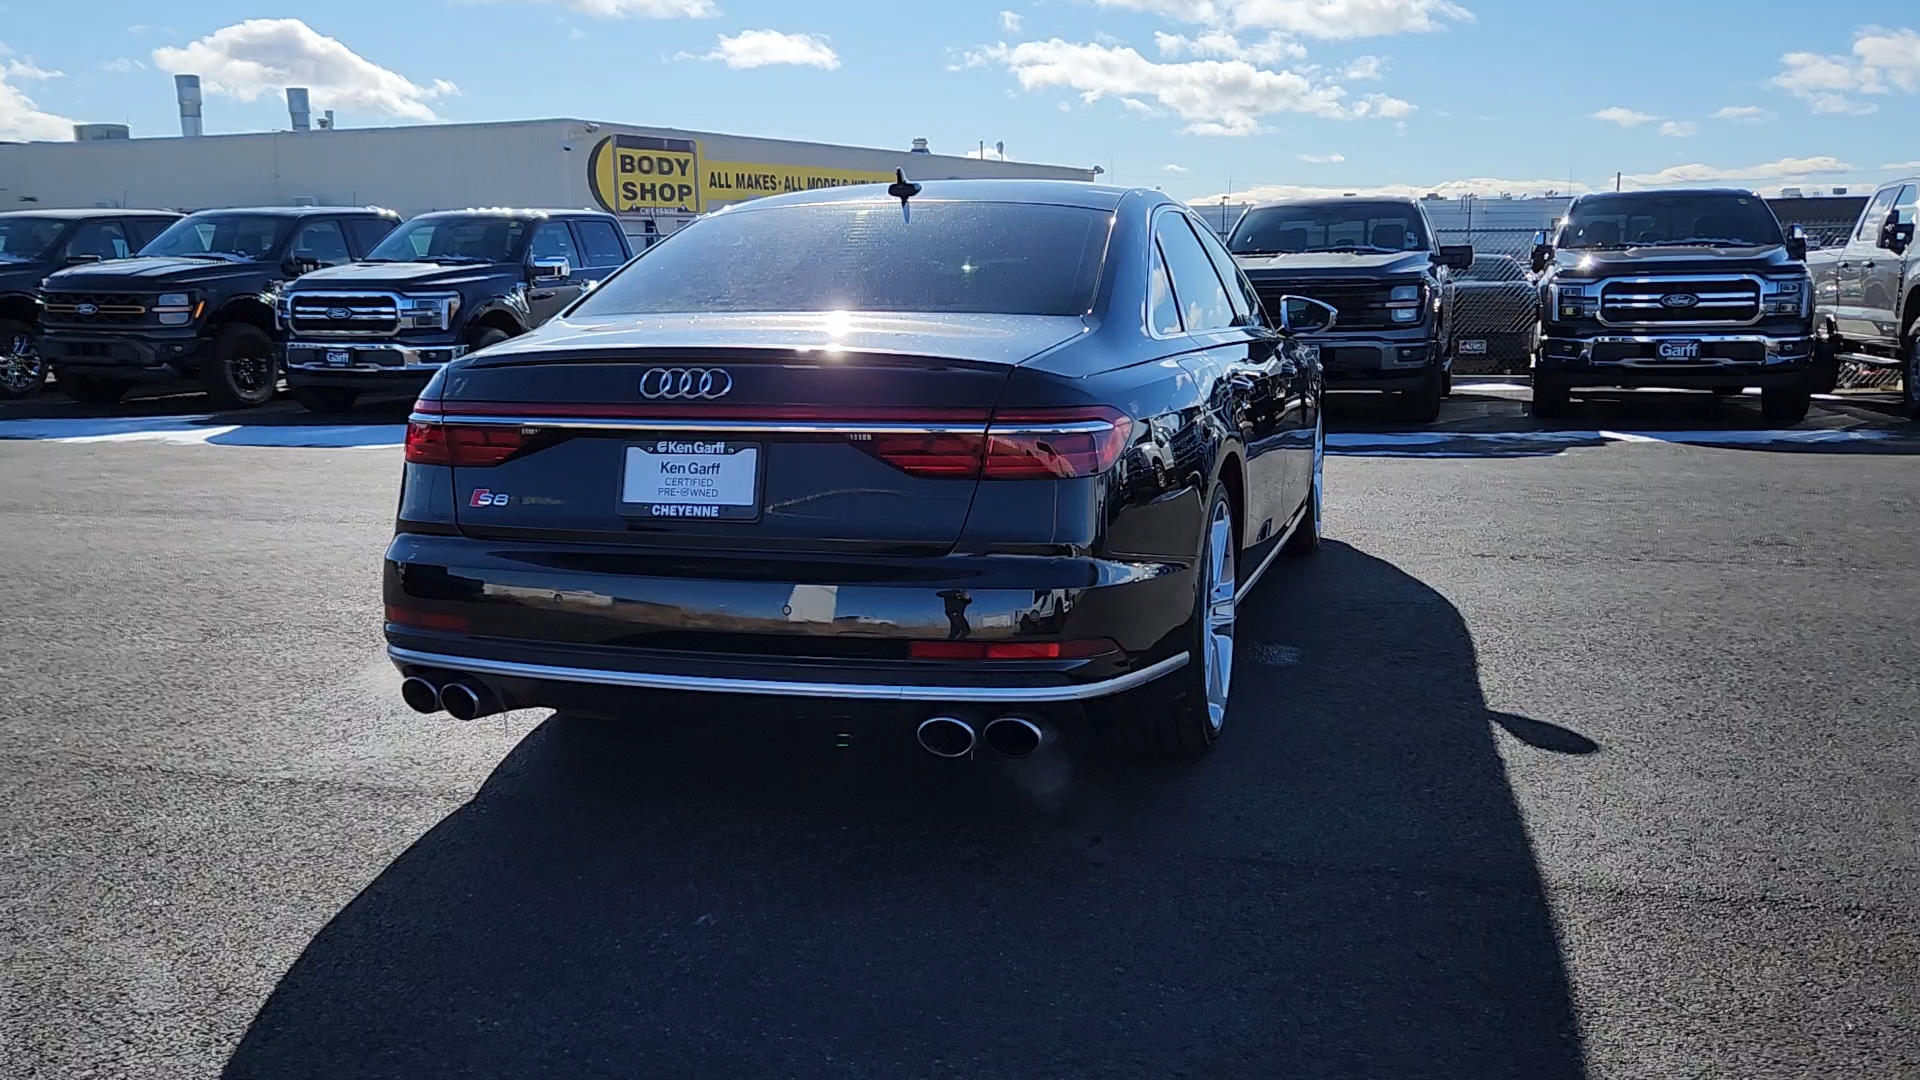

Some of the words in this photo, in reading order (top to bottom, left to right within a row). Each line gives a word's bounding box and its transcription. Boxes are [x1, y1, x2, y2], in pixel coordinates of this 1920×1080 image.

[620, 154, 690, 177] BODY
[709, 171, 732, 189] ALL
[736, 173, 777, 191] MAKES
[784, 175, 804, 192] ALL
[622, 181, 692, 202] SHOP
[640, 207, 679, 215] CHEYENNE
[1659, 343, 1698, 357] Garff
[326, 352, 349, 363] Garff
[668, 441, 693, 453] Ken
[694, 442, 725, 454] Garff
[660, 461, 686, 475] Ken
[688, 462, 721, 475] Garff
[664, 477, 714, 487] CERTIFIED
[474, 491, 509, 507] S8
[651, 504, 719, 517] CHEYENNE
